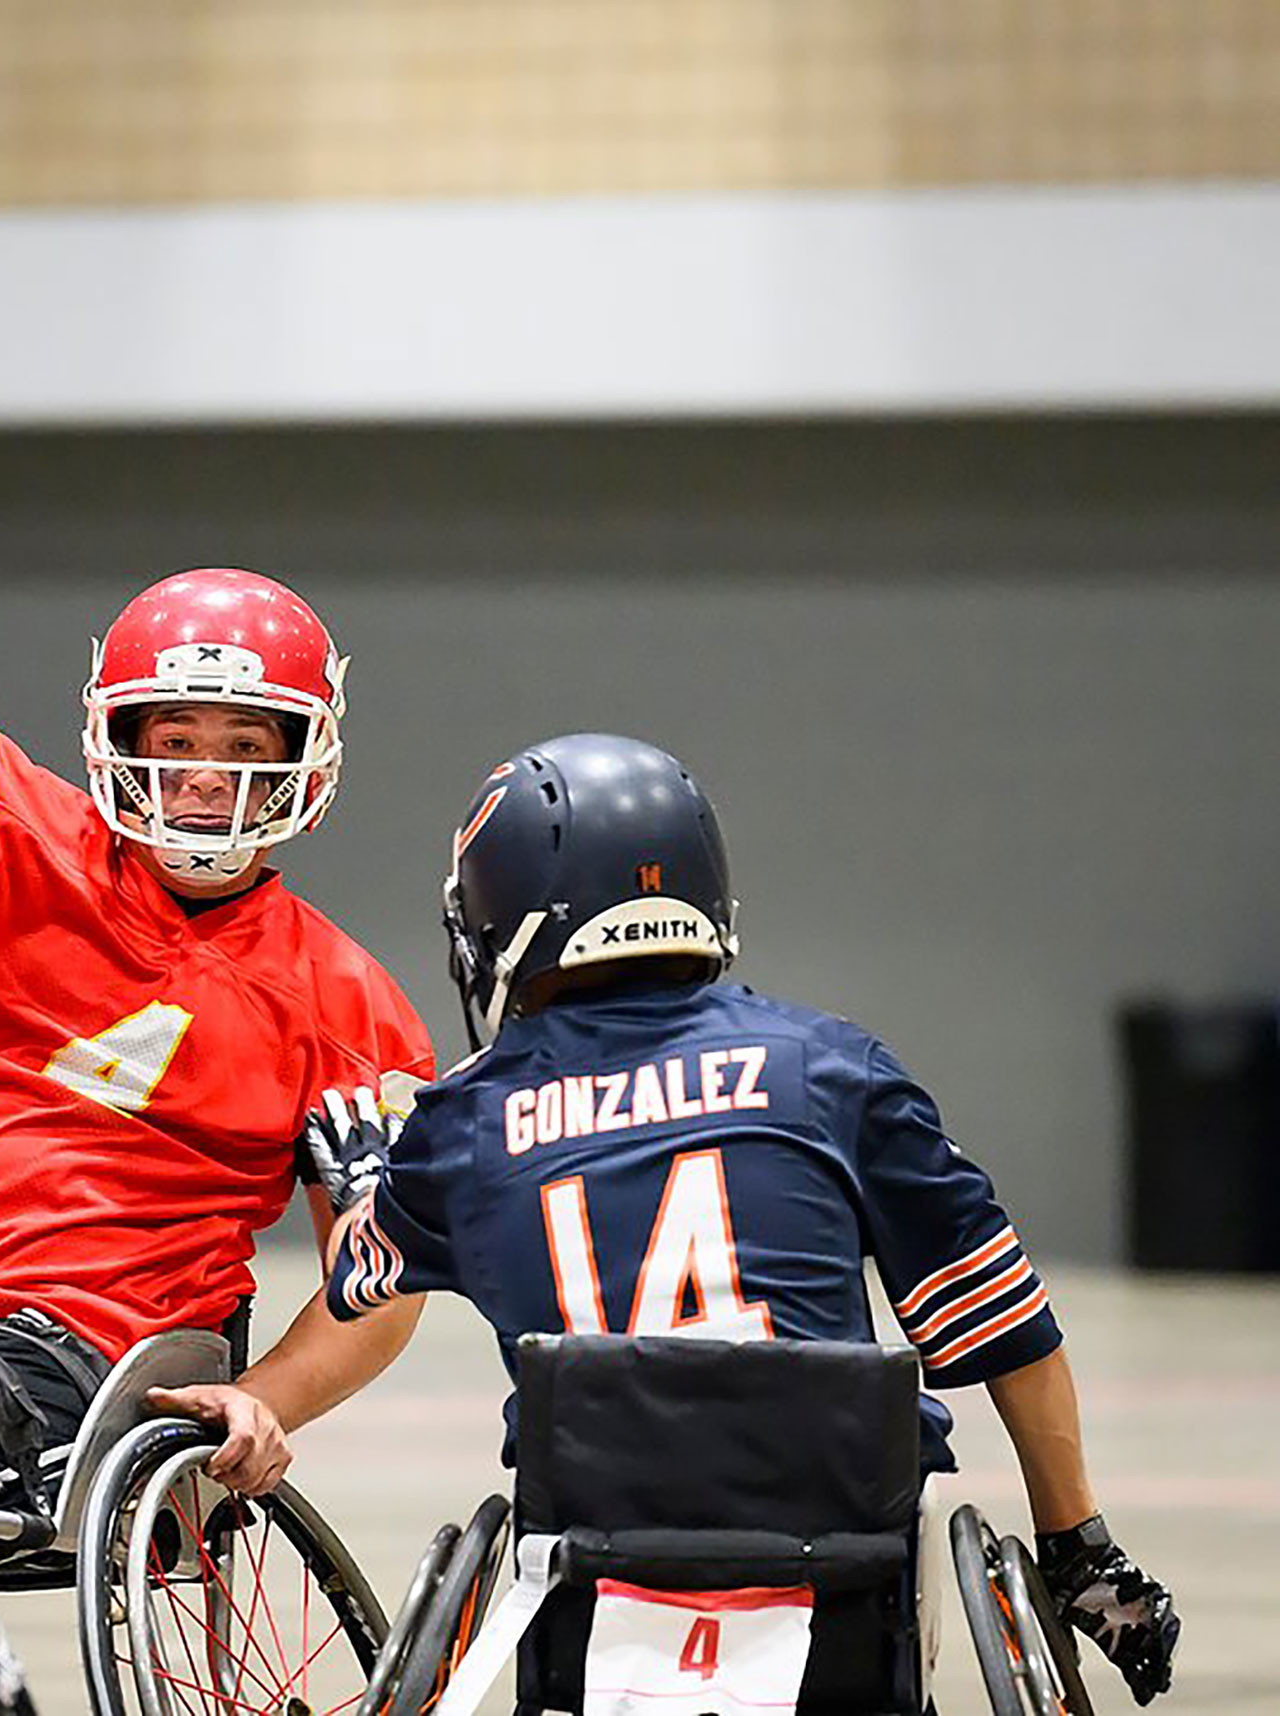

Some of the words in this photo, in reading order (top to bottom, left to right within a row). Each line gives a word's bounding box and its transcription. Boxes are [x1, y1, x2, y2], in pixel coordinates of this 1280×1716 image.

[601, 920, 698, 945] XENITH
[42, 1000, 194, 1119] 4
[505, 1045, 769, 1157] GONZALEZ
[540, 1147, 775, 1342] 14
[678, 1616, 720, 1681] 4
